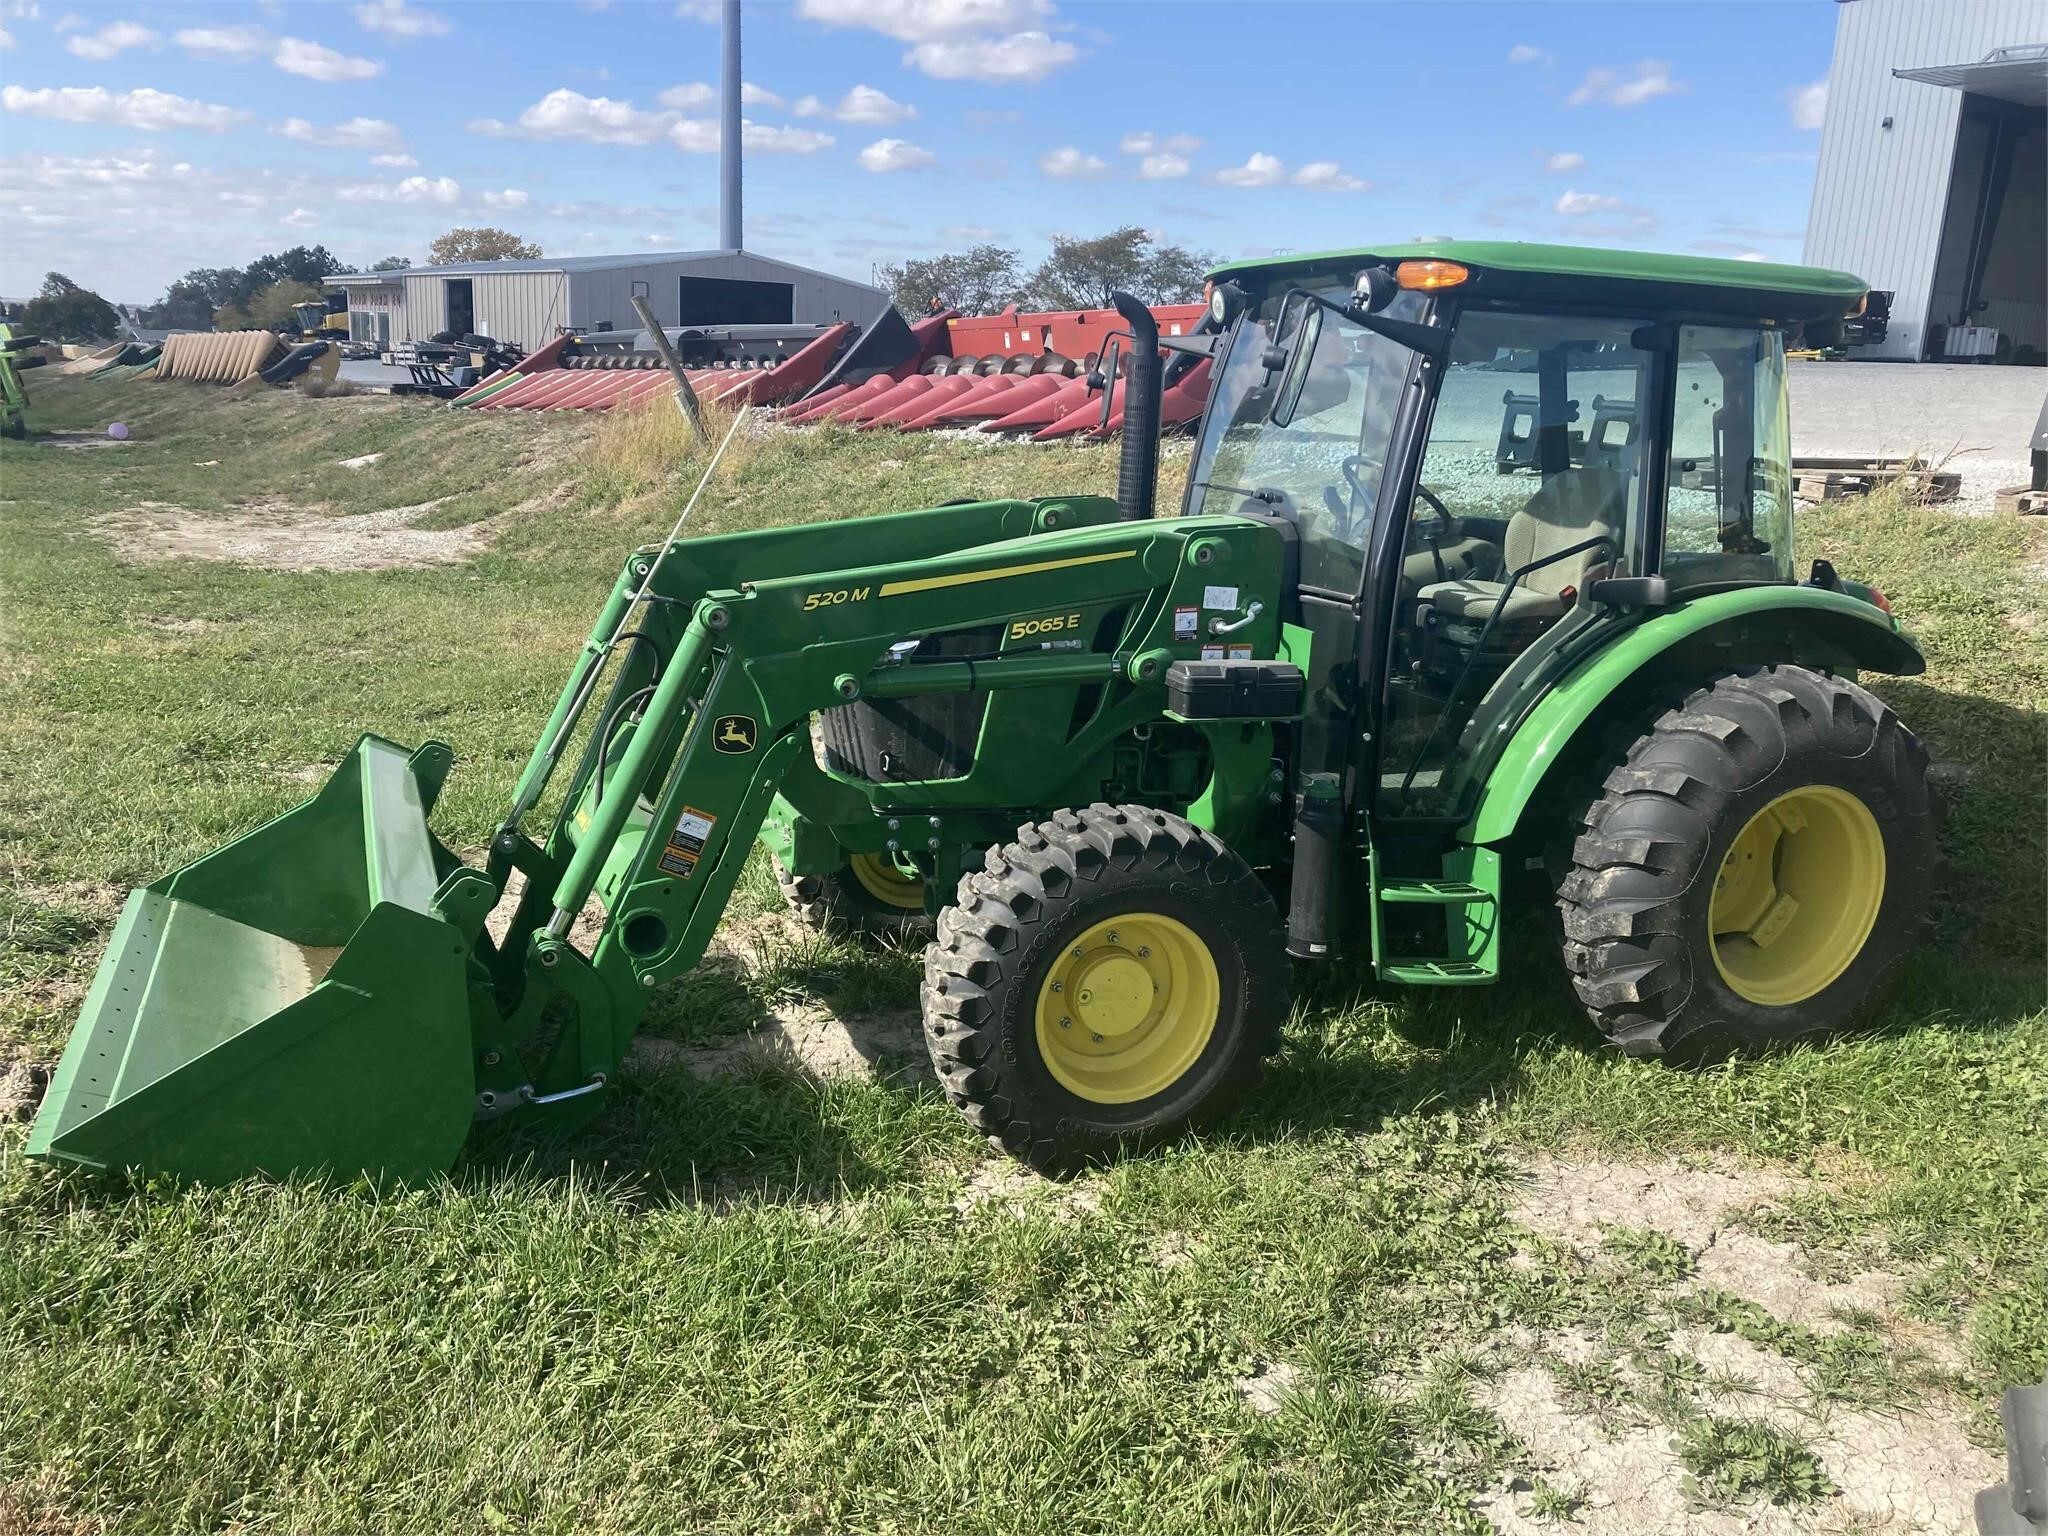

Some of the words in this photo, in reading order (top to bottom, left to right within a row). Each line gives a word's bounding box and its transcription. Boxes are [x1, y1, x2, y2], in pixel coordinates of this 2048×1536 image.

[802, 590, 849, 611] 520
[850, 586, 871, 602] M
[1010, 616, 1065, 640] 5065
[1066, 613, 1081, 629] E
